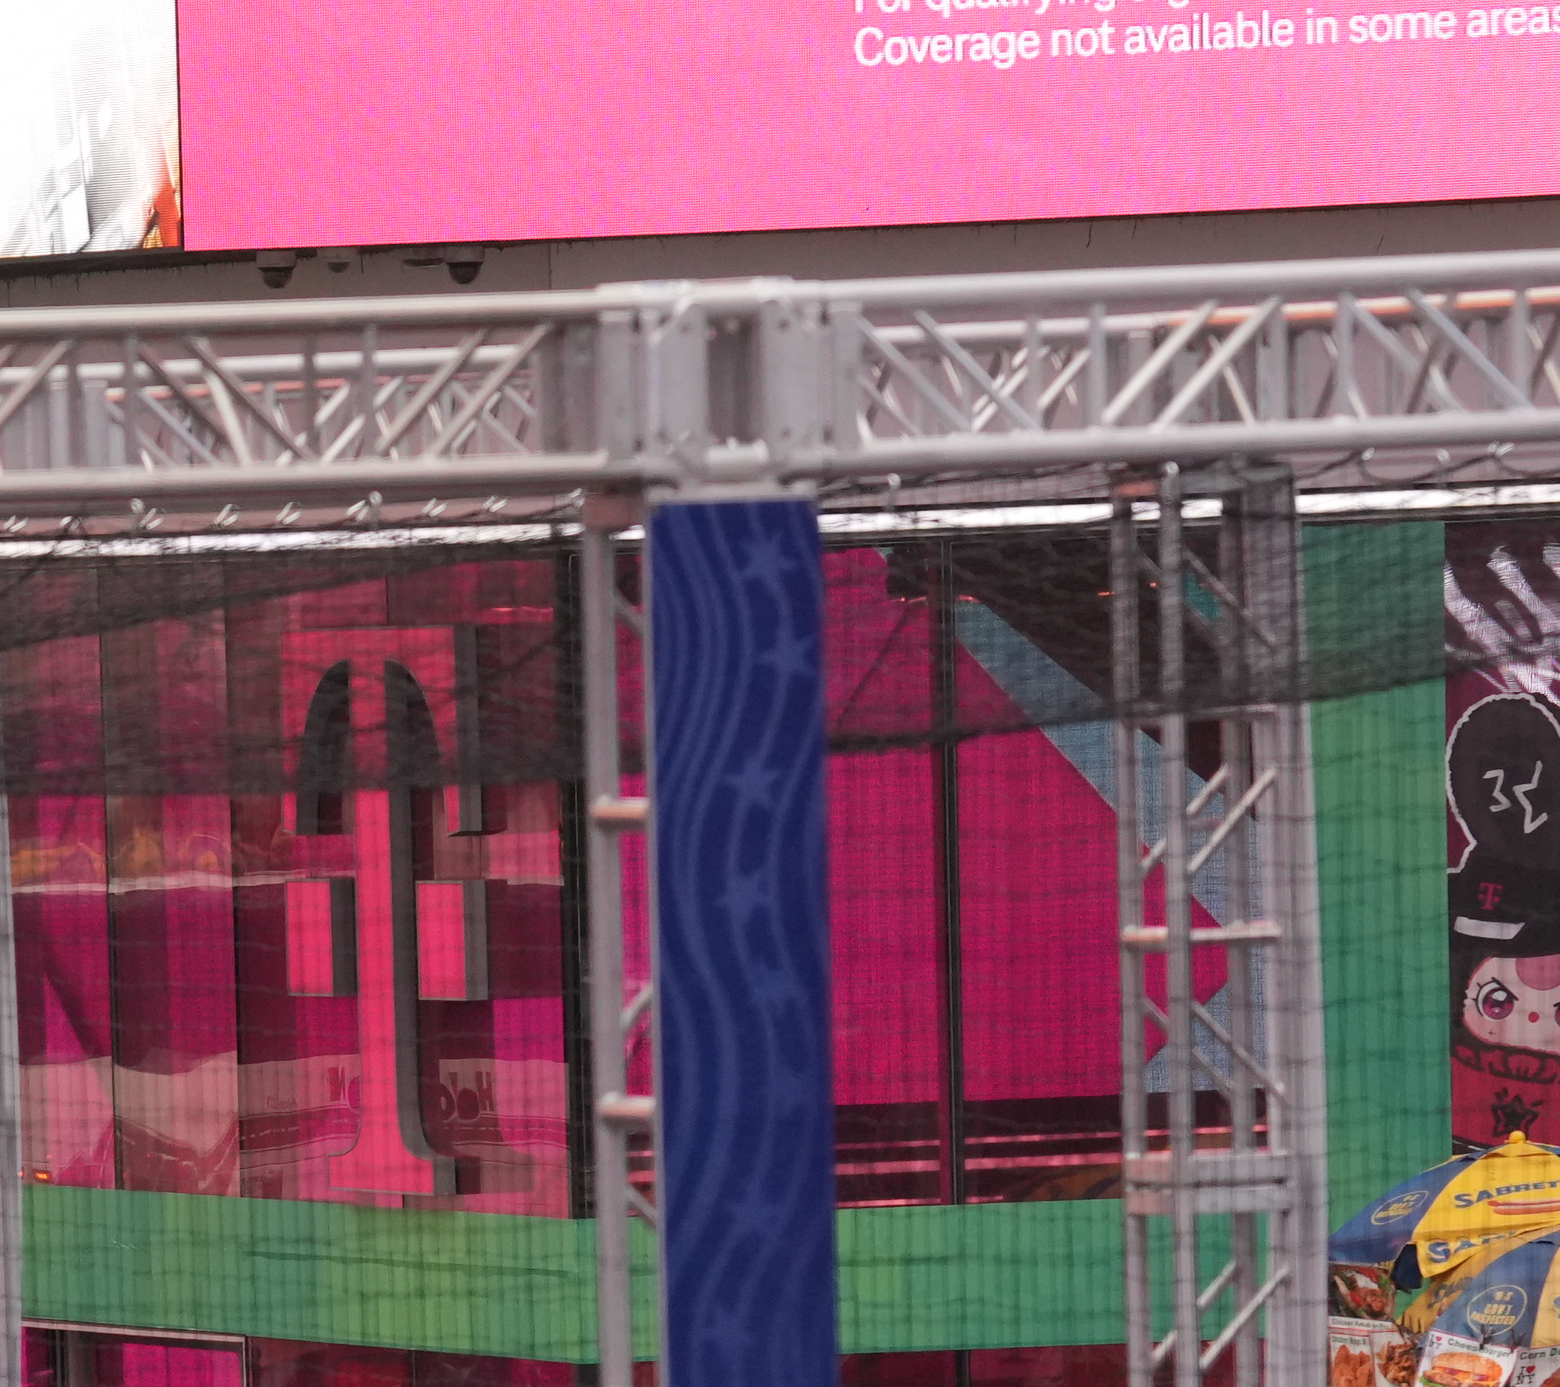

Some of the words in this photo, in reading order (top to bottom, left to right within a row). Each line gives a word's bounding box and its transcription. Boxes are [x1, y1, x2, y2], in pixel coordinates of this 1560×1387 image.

[853, 26, 1042, 69] Coverage
[1049, 22, 1115, 57] not
[1124, 9, 1295, 55] available
[1306, 7, 1340, 46] in
[1349, 12, 1457, 42] some
[1519, 1350, 1548, 1361] Corn
